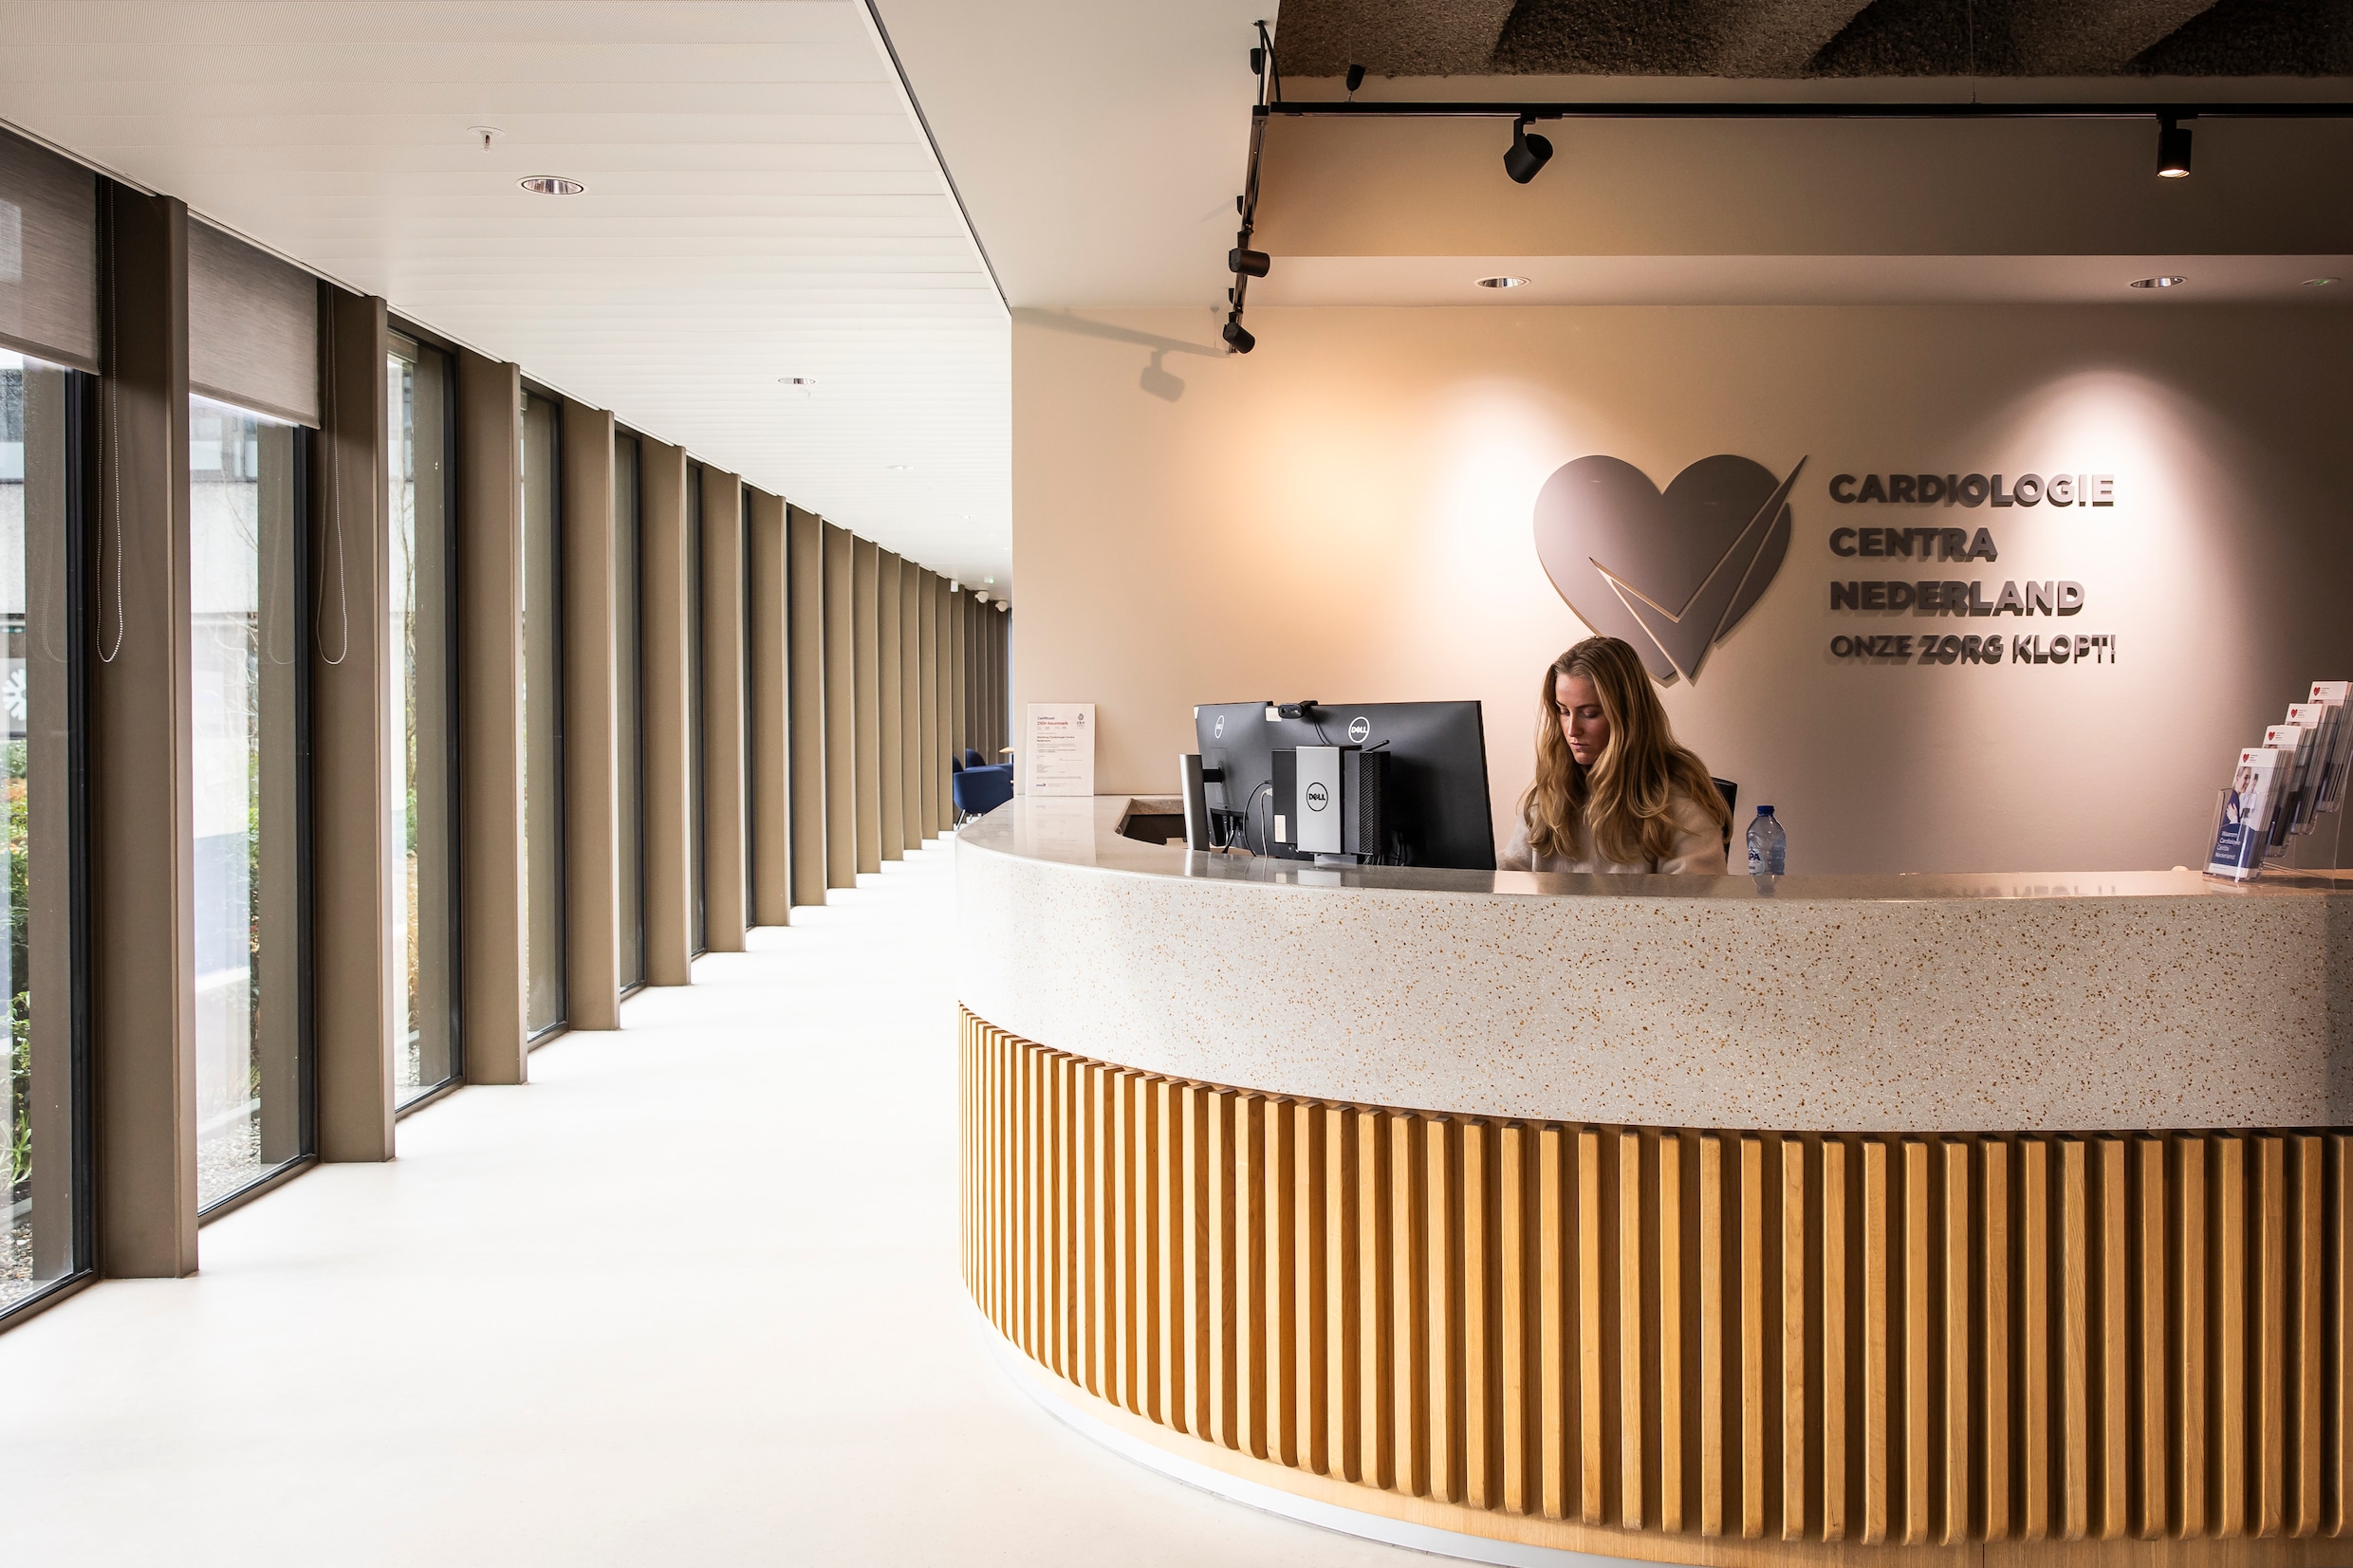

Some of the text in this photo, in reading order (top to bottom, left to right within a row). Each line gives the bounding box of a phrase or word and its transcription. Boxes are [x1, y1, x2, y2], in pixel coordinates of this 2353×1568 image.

[1828, 472, 2115, 505] CARDIOLOGIE
[1828, 526, 1998, 559] CENTRA
[1829, 580, 2085, 612] NEDERLAND
[1829, 634, 2116, 657] ONZE ZORG KLOPT!
